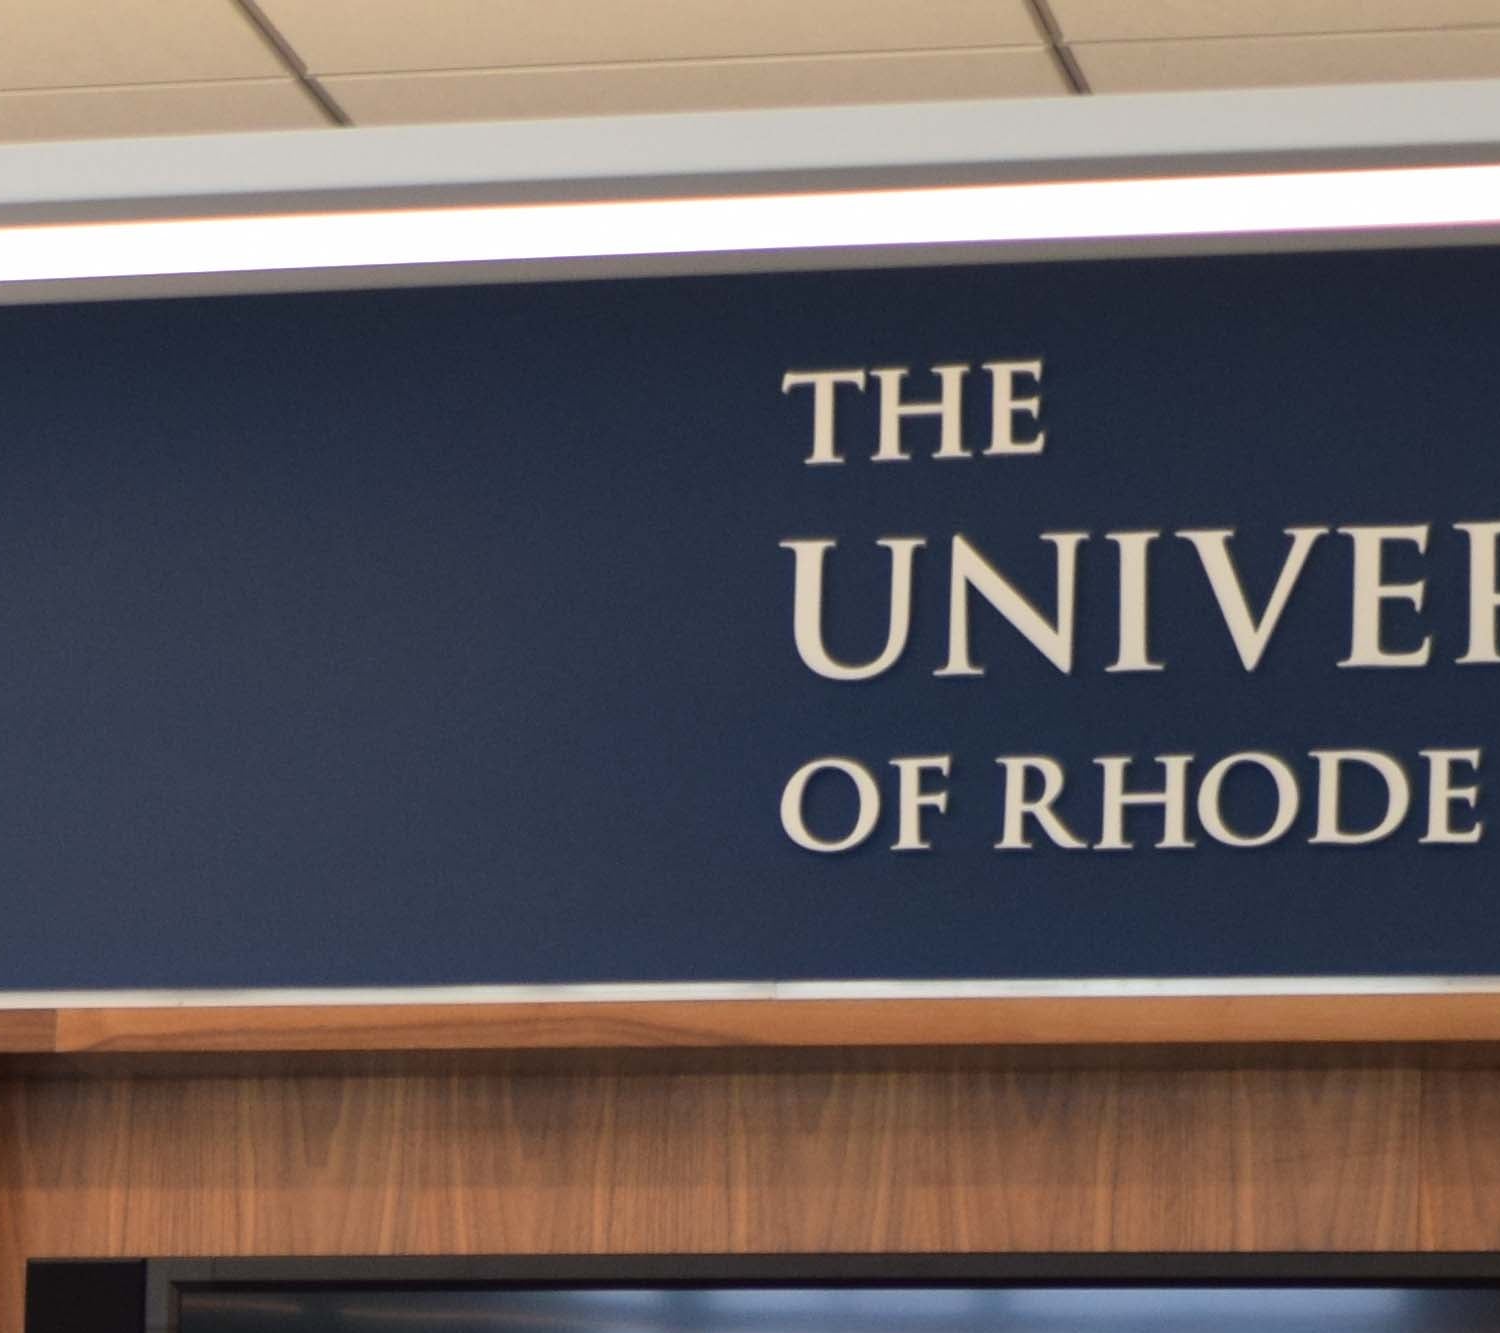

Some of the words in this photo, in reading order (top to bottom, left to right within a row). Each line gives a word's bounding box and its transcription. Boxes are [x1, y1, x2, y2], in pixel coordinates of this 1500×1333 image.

[781, 360, 1046, 465] THE
[780, 755, 951, 853] OF
[993, 748, 1483, 850] RHODE
